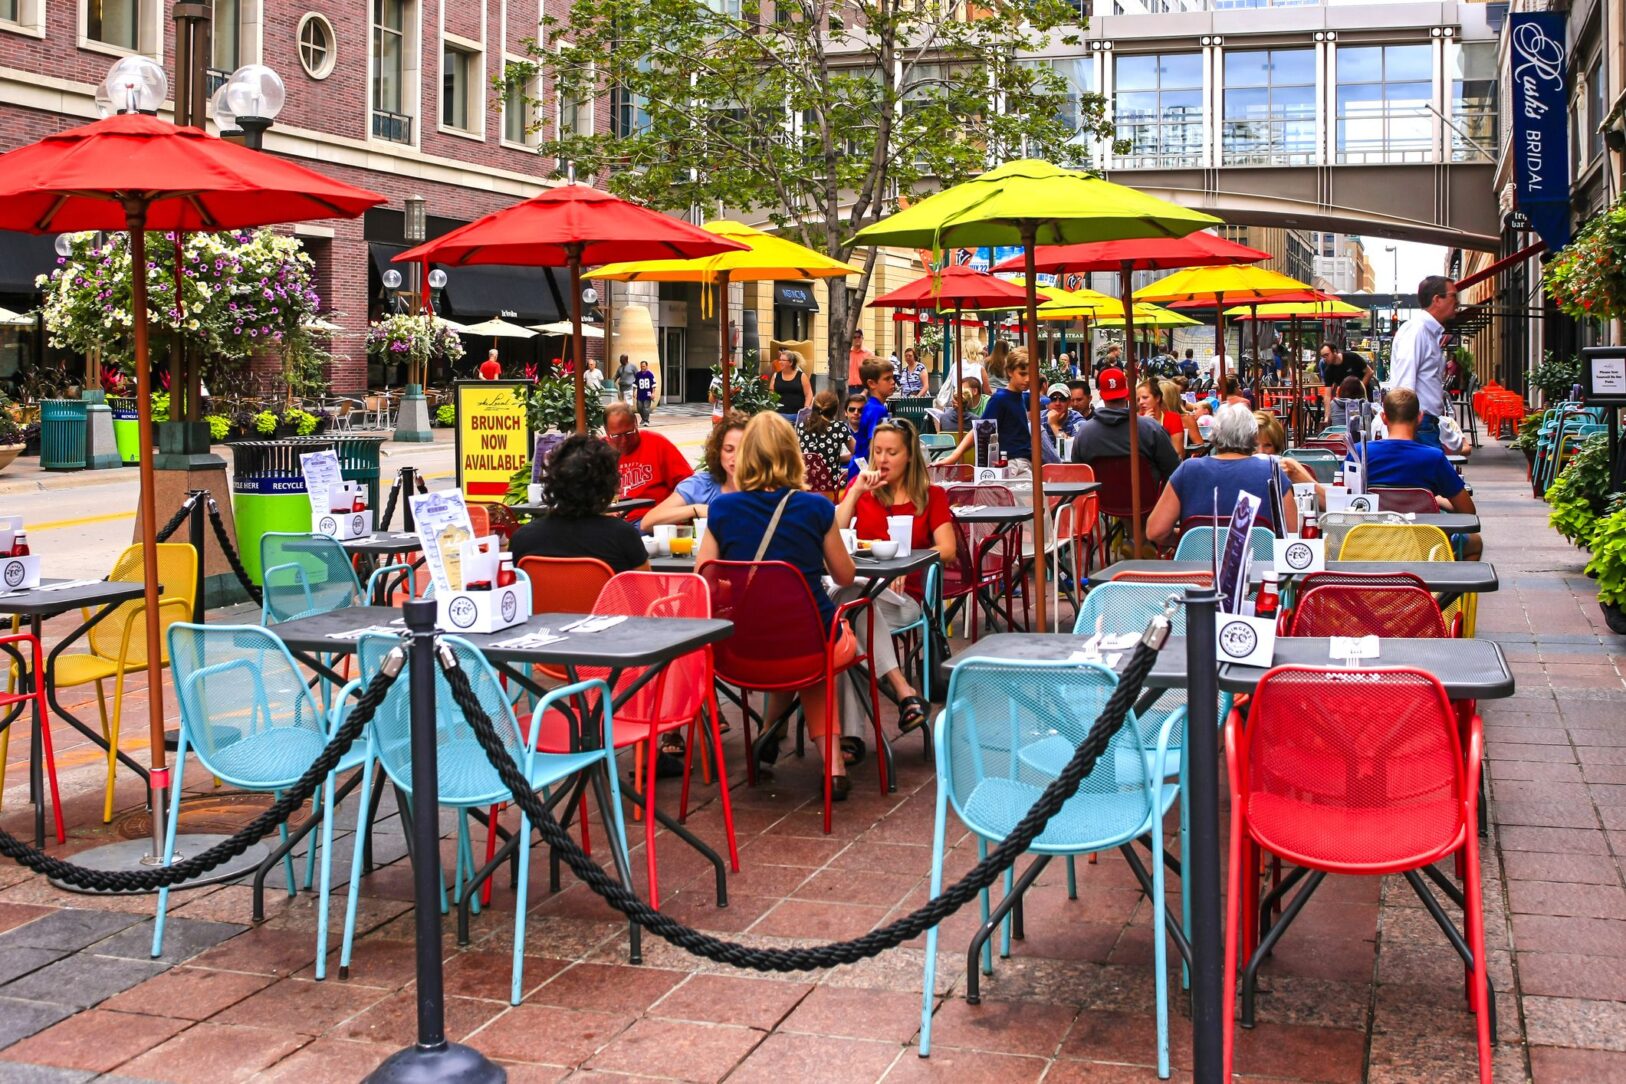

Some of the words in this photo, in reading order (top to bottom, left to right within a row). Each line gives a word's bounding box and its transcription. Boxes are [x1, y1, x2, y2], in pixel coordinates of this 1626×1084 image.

[1513, 22, 1564, 119] Rush's
[1526, 130, 1543, 192] BRIDAL
[980, 264, 988, 272] 22
[639, 378, 650, 389] 88
[471, 415, 520, 430] BRUNCH
[481, 434, 507, 450] NOW
[464, 454, 525, 471] AVAILABLE
[243, 482, 259, 490] HERE
[272, 482, 304, 490] RECYCLE
